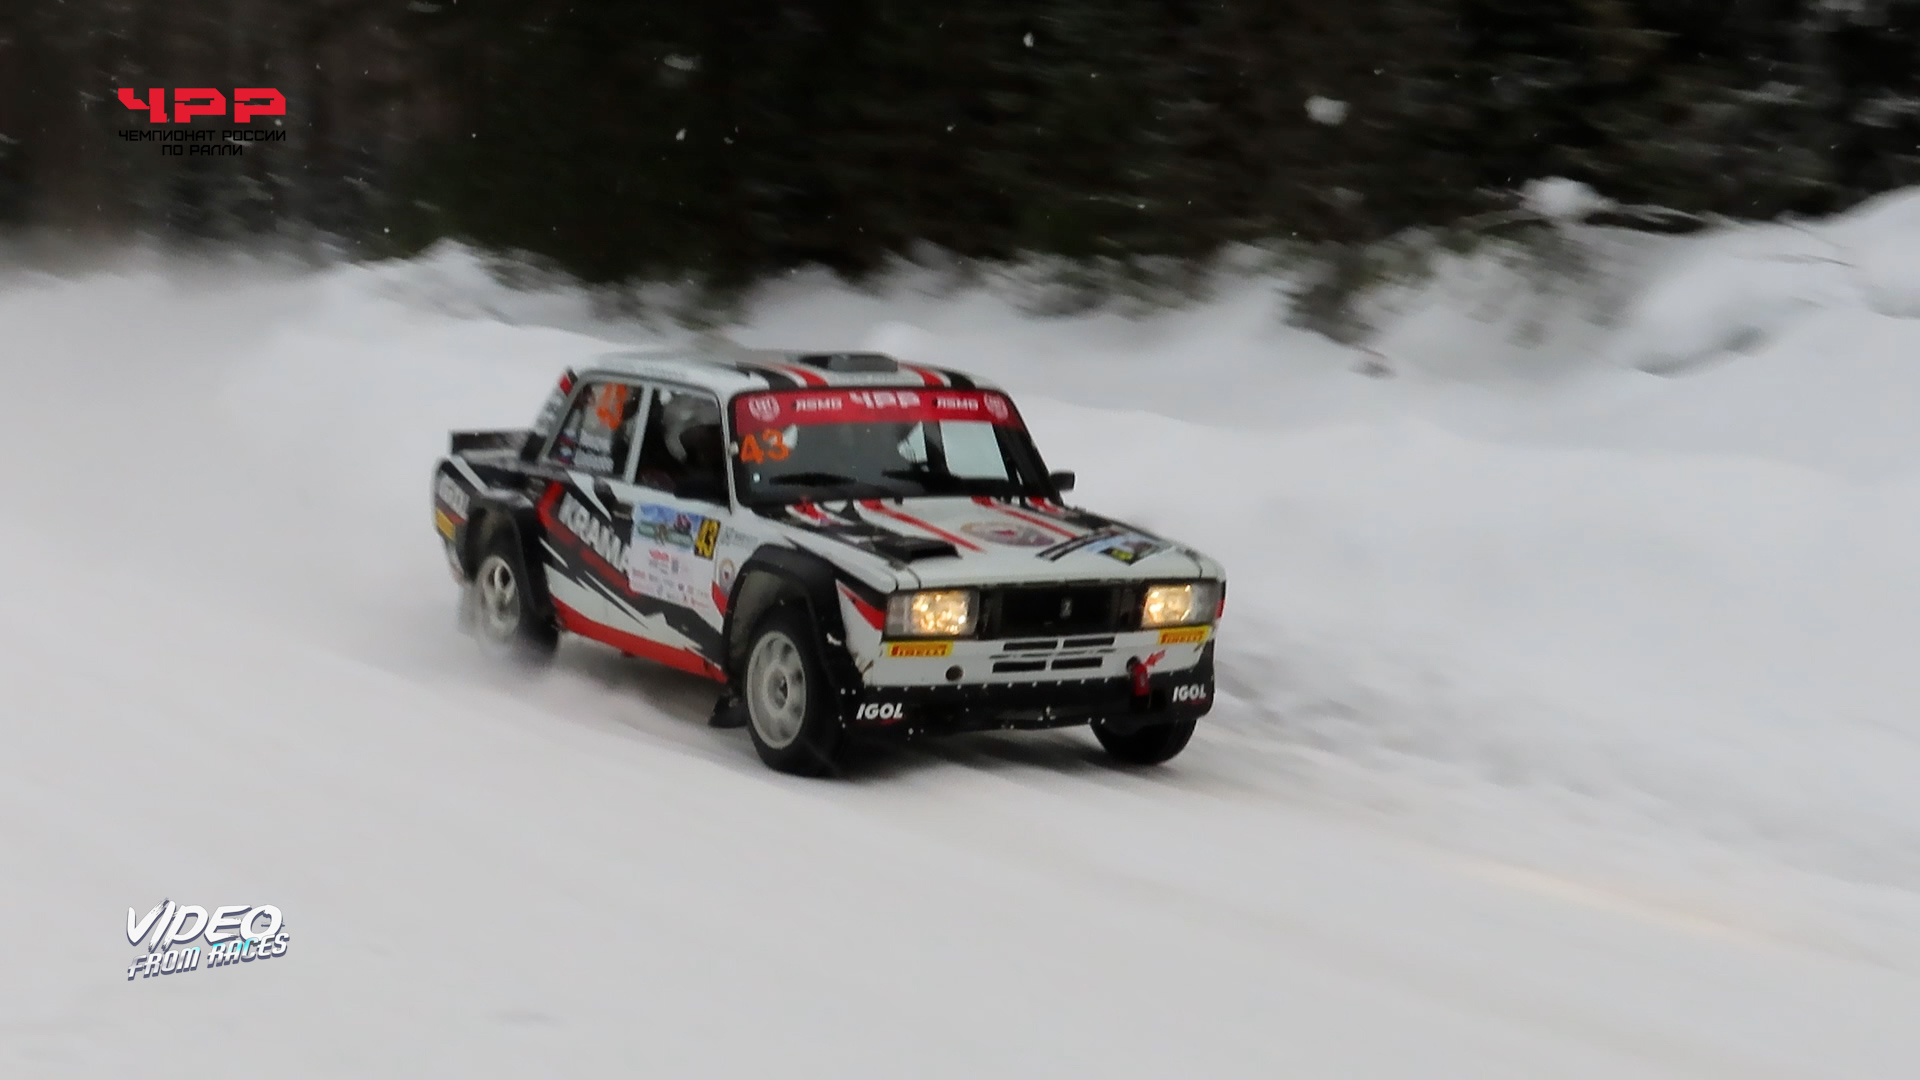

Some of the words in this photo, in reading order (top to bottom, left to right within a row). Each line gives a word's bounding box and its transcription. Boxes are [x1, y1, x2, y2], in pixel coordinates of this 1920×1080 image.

[740, 428, 790, 464] 43
[1161, 629, 1205, 643] PIRELLI
[891, 644, 948, 656] PIRELLI
[1172, 683, 1207, 703] IGOL
[855, 702, 904, 720] IGOL
